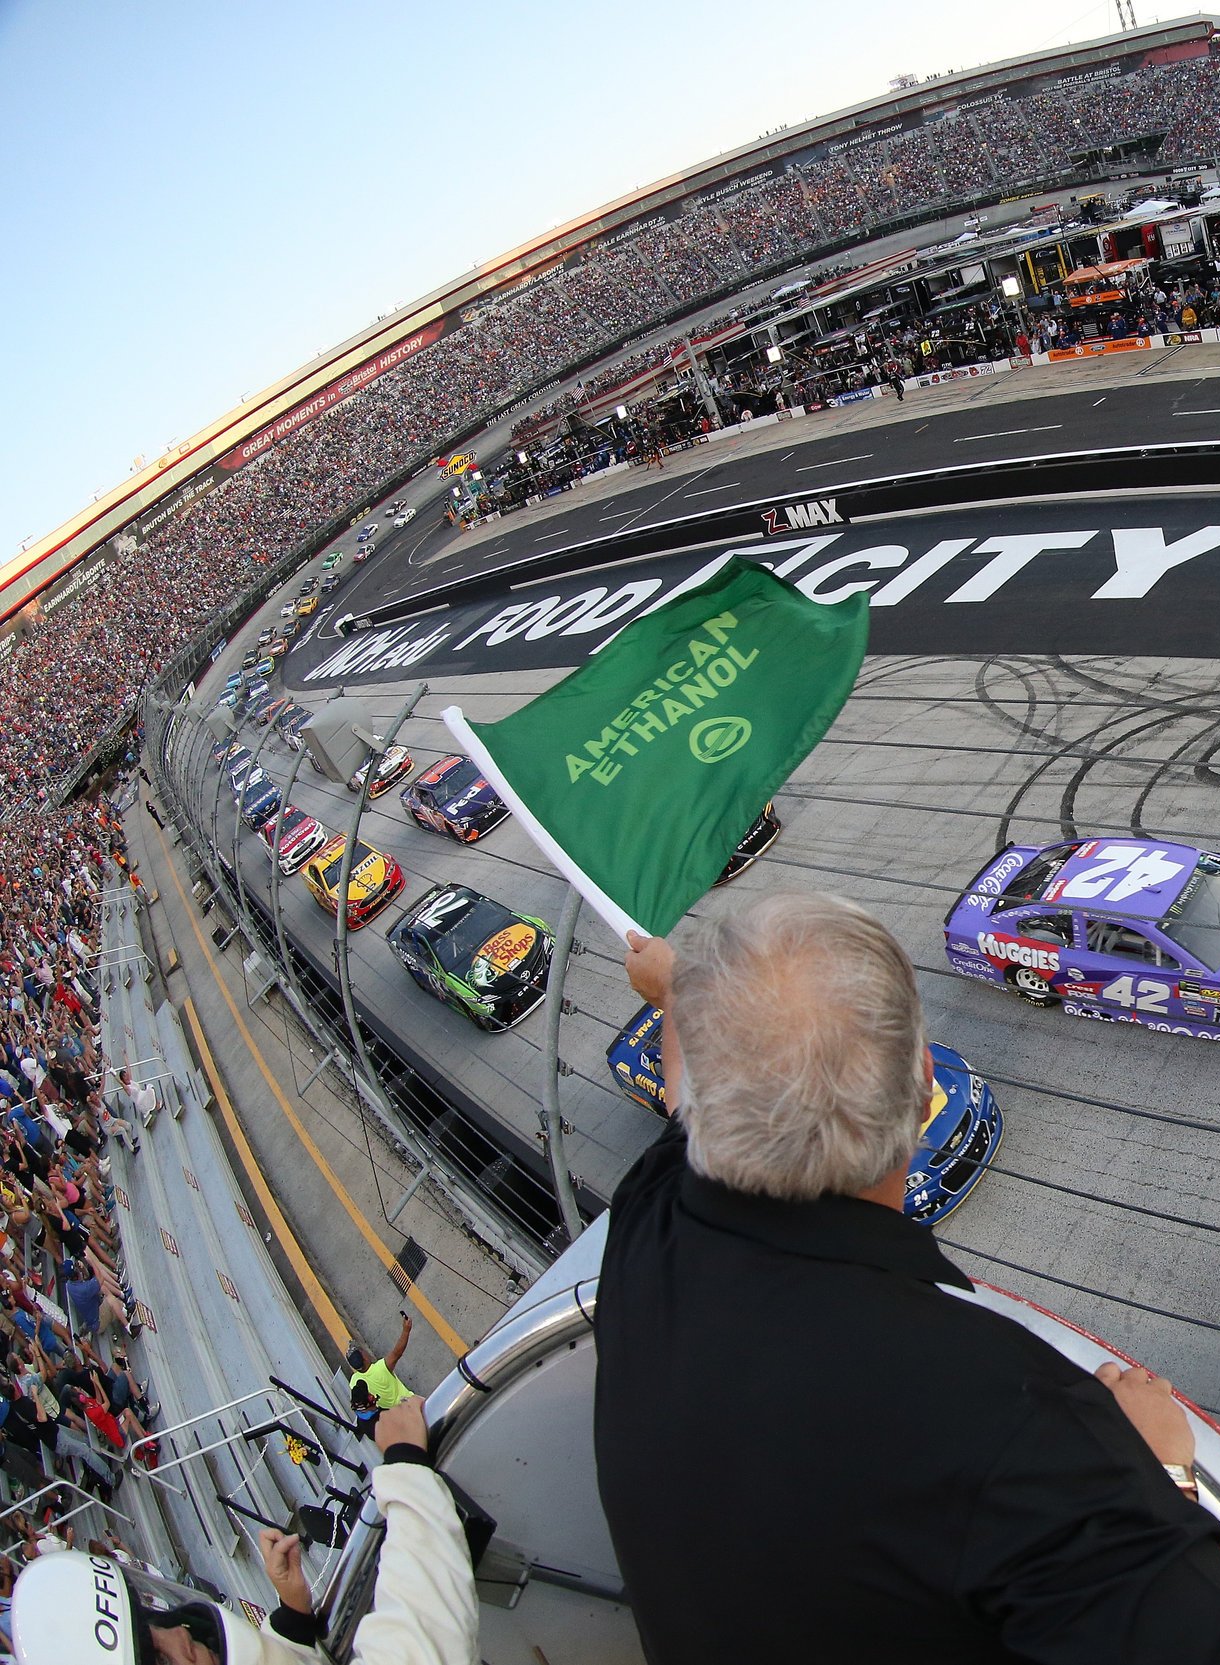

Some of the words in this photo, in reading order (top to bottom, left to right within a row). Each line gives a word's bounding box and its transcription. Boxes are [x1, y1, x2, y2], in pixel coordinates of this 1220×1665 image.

[1057, 73, 1085, 84] BATTLE
[1095, 66, 1121, 77] BRISTOL
[829, 141, 849, 153] TONY
[849, 132, 876, 147] HELMET
[877, 122, 903, 138] THROW
[716, 183, 738, 197] BUSCH
[738, 170, 773, 191] WEEKEND
[597, 237, 616, 250] DALE
[1184, 334, 1199, 342] NRA
[242, 430, 275, 458] GREAT
[276, 396, 326, 436] MOMENTS
[327, 392, 336, 402] in
[352, 363, 377, 387] Bristol
[380, 335, 424, 369] HISTORY
[485, 416, 498, 427] THE
[497, 408, 512, 423] LAST
[510, 397, 529, 413] GREAT
[528, 379, 562, 402] COLOSSEUM
[443, 451, 476, 477] SUNOCO
[141, 511, 168, 535] BRUTON
[166, 500, 184, 515] BUYS
[183, 490, 196, 504] THE
[195, 476, 215, 494] TRACK
[43, 558, 107, 614] EARNHARDT/LABONTE
[453, 578, 665, 652] FOOD
[303, 618, 453, 683] UNOH.edu
[564, 611, 741, 785] AMERICAN
[588, 645, 761, 787] ETHANOL
[446, 779, 488, 815] FedE
[737, 825, 762, 850] CAMRY
[967, 851, 1025, 913] Coca-Cola
[1060, 844, 1187, 903] 42
[482, 929, 512, 956] Bass
[492, 938, 514, 959] Pro
[499, 932, 535, 966] Shops
[976, 931, 1062, 973] HUGGIES
[952, 957, 996, 974] CreditOne
[1063, 982, 1095, 993] Crest
[1102, 974, 1171, 1014] 42
[635, 1073, 658, 1097] AUTO
[913, 1189, 929, 1207] 24
